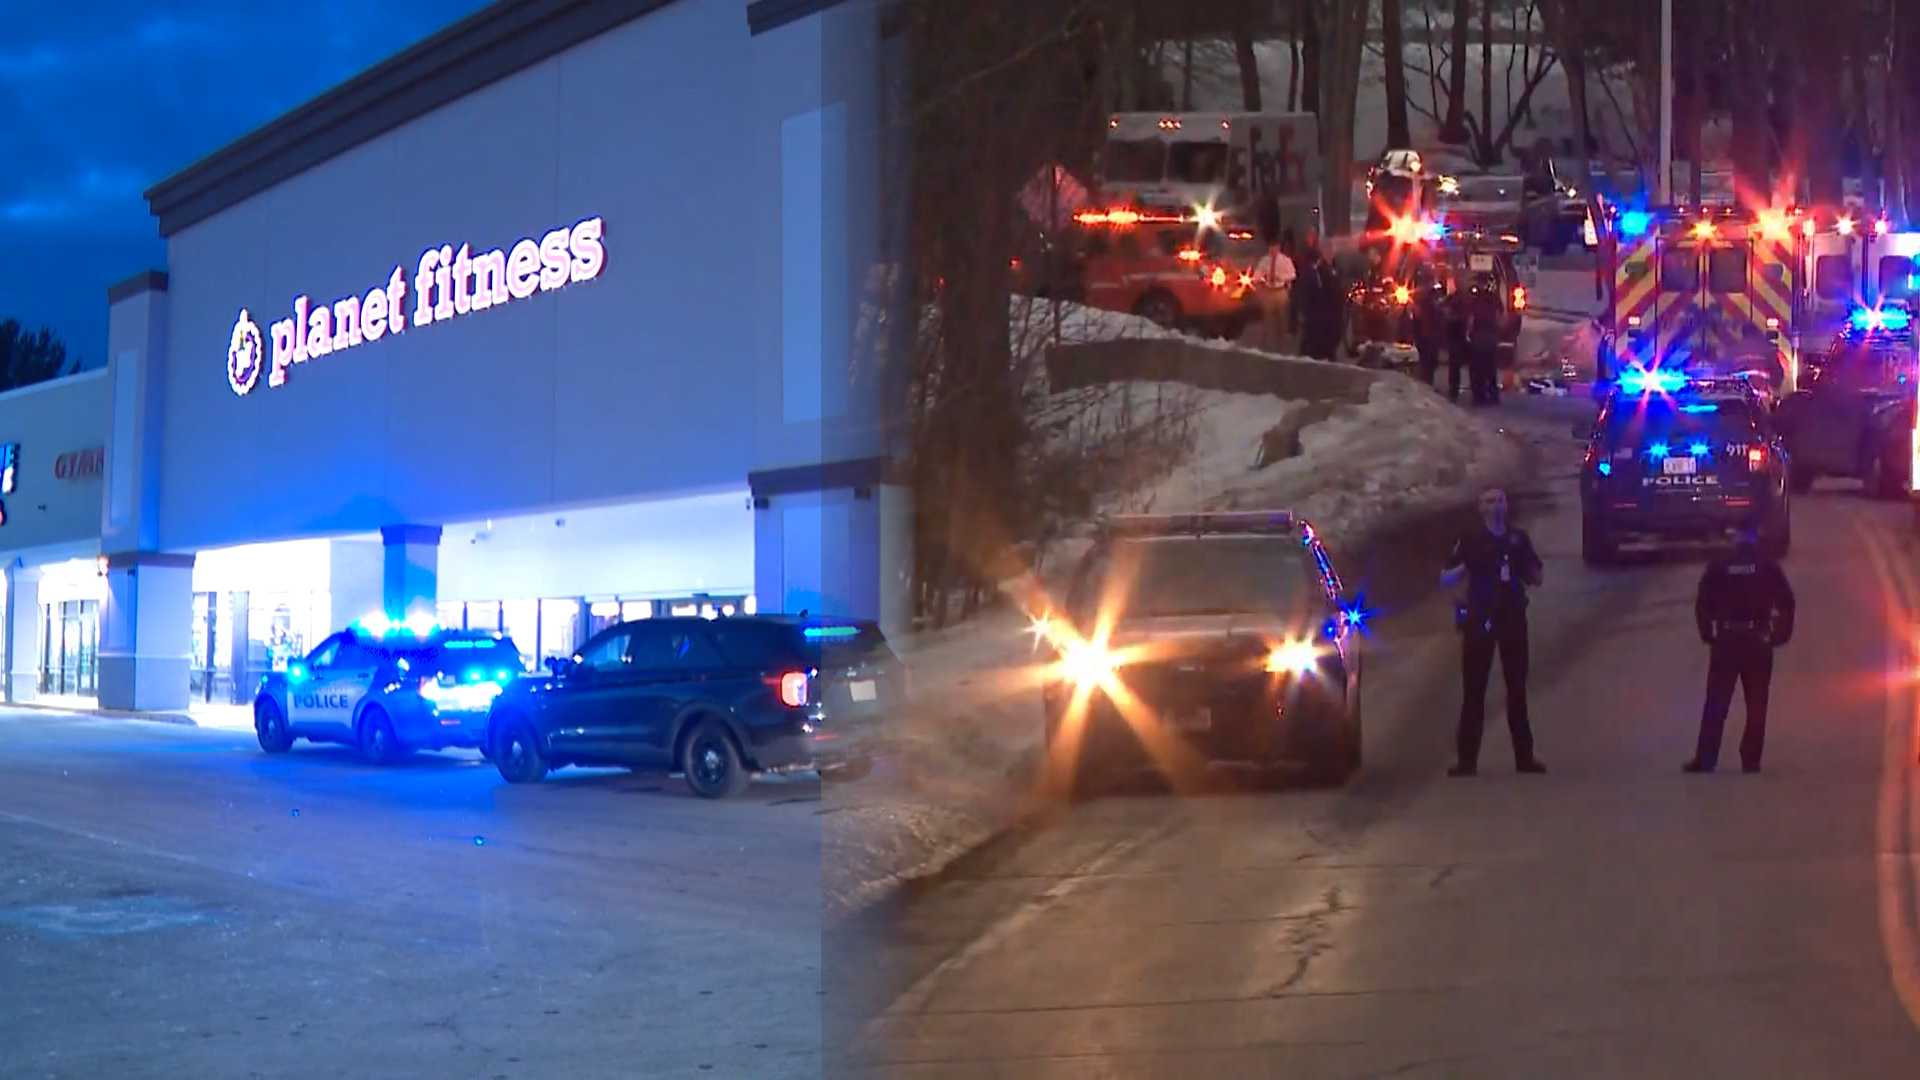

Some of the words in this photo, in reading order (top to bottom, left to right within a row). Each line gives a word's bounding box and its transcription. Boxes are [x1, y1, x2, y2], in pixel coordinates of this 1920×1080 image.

[268, 264, 407, 388] planet
[413, 216, 605, 327] fitness
[1726, 443, 1748, 457] 911
[1642, 474, 1719, 487] POLICE
[293, 694, 349, 709] POLICE
